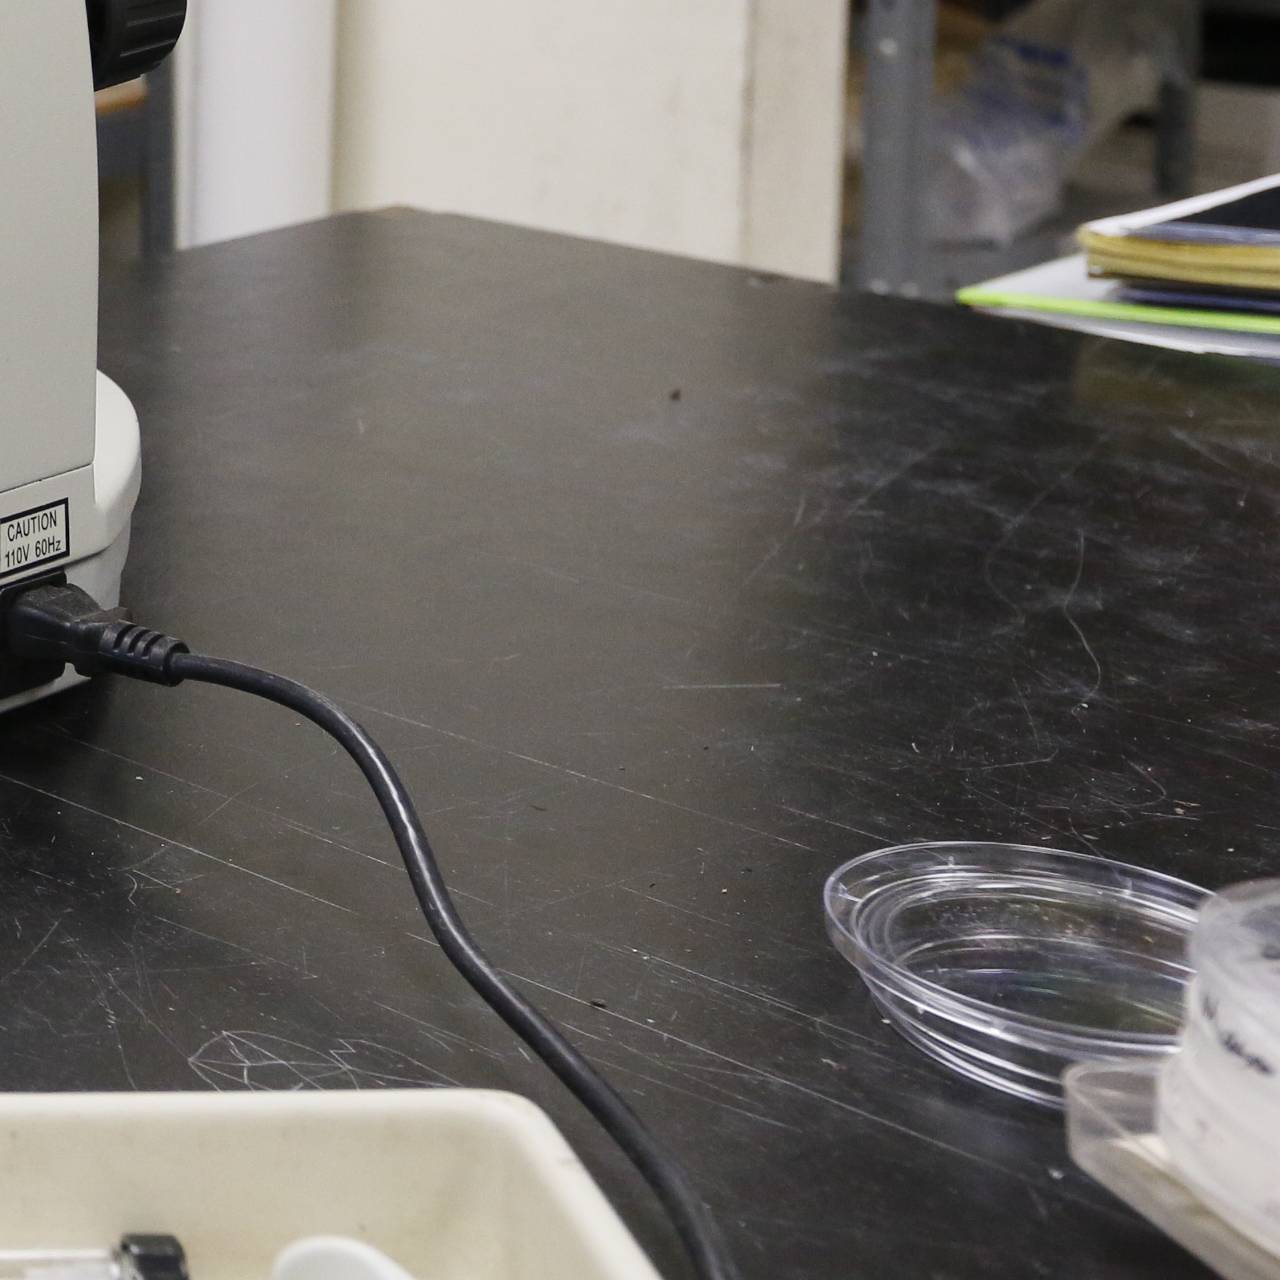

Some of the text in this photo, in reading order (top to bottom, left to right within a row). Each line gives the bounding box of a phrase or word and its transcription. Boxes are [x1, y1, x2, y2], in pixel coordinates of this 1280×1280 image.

[7, 510, 57, 542] CAUTION
[4, 536, 61, 568] 110V 60Hz
